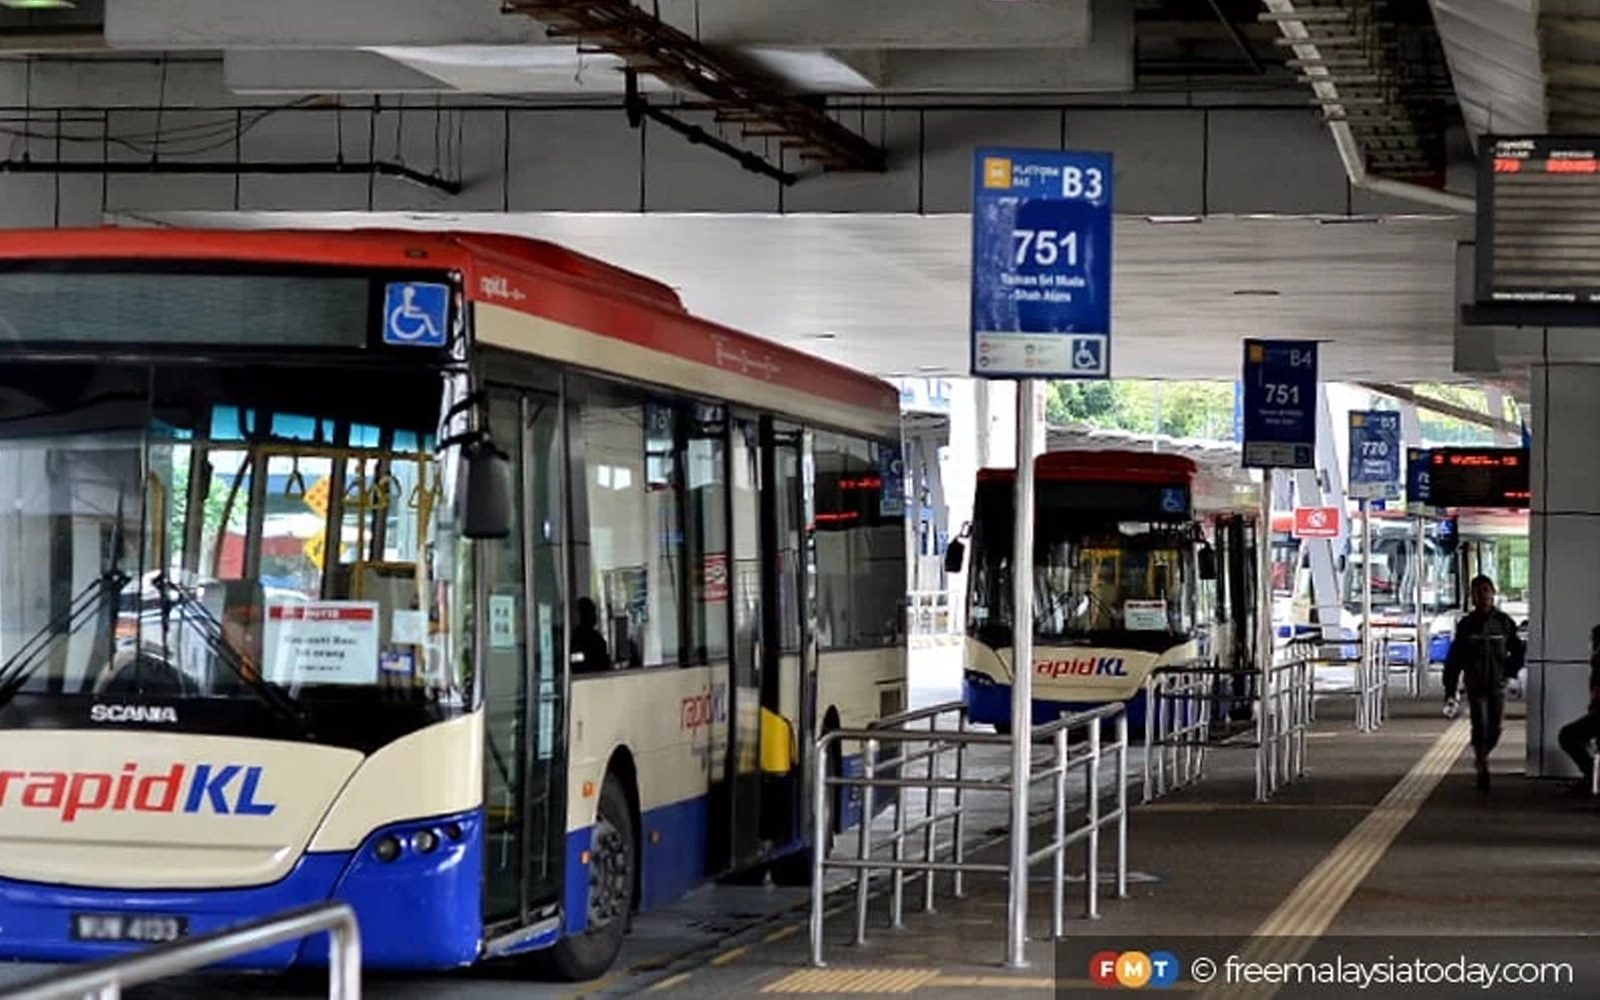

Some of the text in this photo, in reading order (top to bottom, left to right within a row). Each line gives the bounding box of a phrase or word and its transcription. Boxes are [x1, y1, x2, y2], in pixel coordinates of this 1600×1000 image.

[1062, 165, 1104, 199] B3
[1012, 230, 1077, 265] 751
[1290, 348, 1312, 367] B4
[1265, 383, 1299, 404] 751
[91, 703, 178, 722] SCANIA
[0, 763, 277, 823] rapidKL
